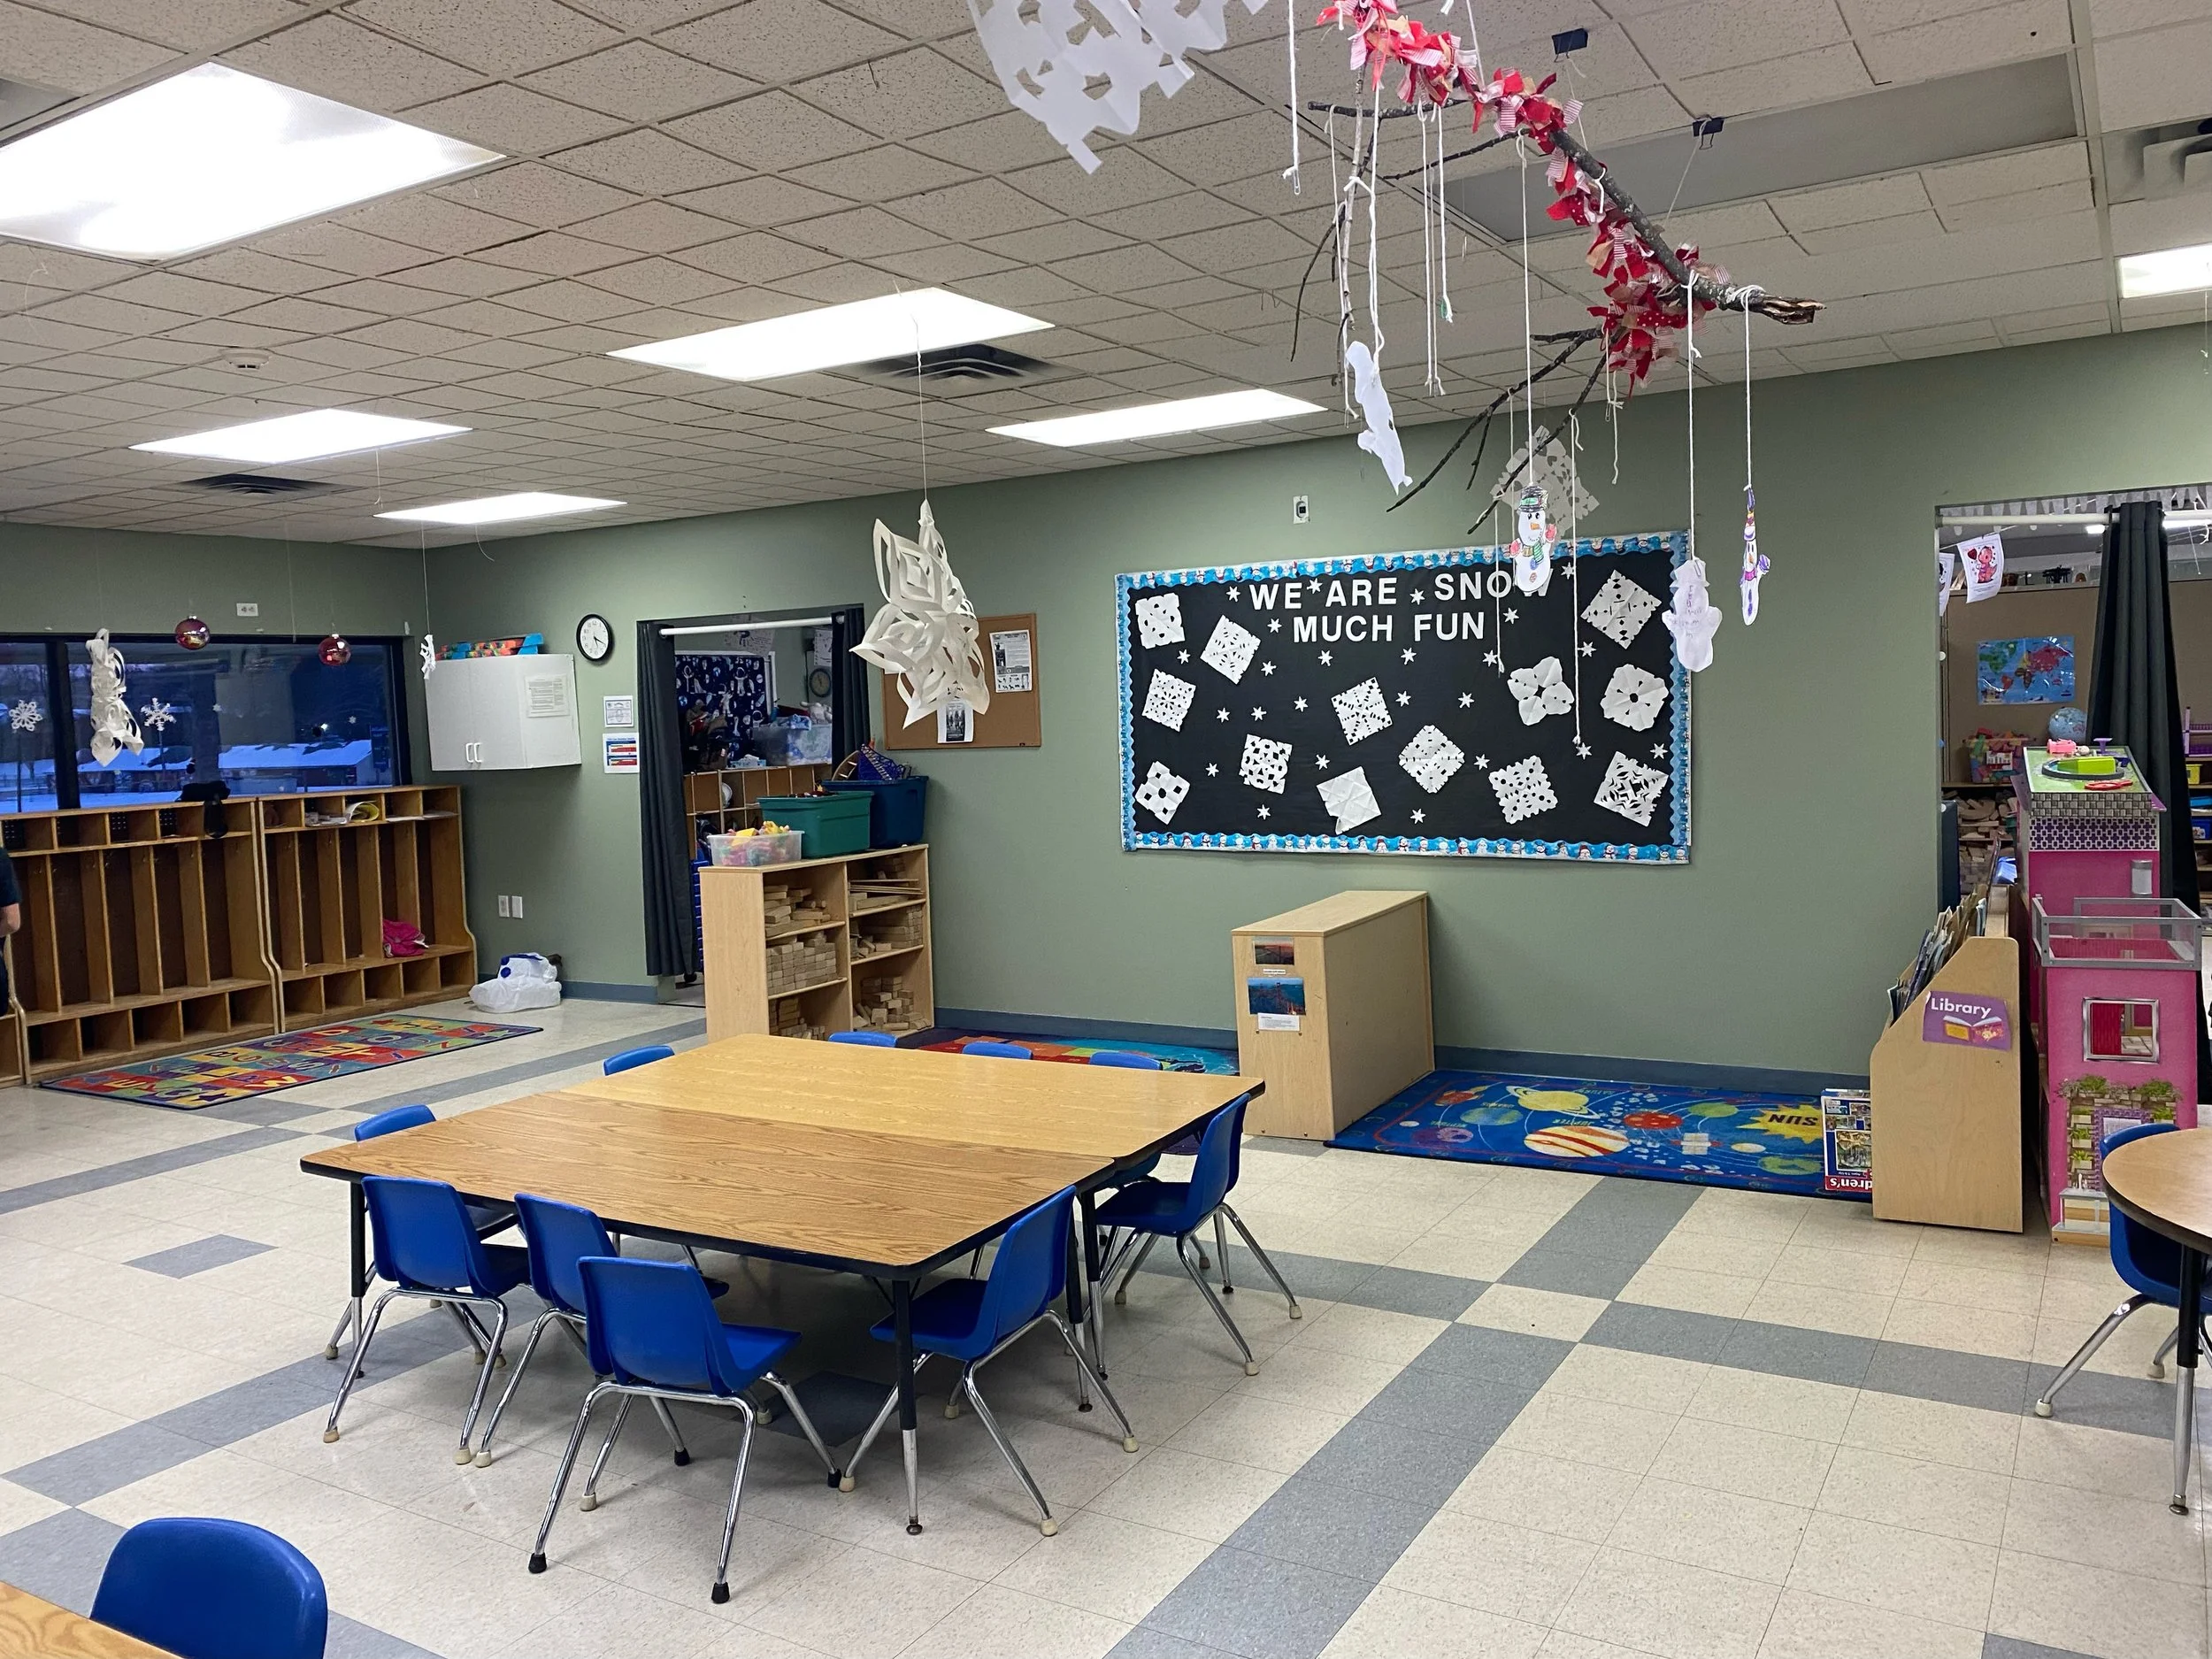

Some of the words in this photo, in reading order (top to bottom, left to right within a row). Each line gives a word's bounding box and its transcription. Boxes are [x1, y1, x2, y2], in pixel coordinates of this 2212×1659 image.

[1249, 582, 1302, 611] WE
[1325, 578, 1397, 607] ARE
[1293, 615, 1393, 643] MUCH
[1415, 611, 1484, 641] FUN
[1931, 997, 1991, 1018] Library
[1768, 1114, 1818, 1126] SUN
